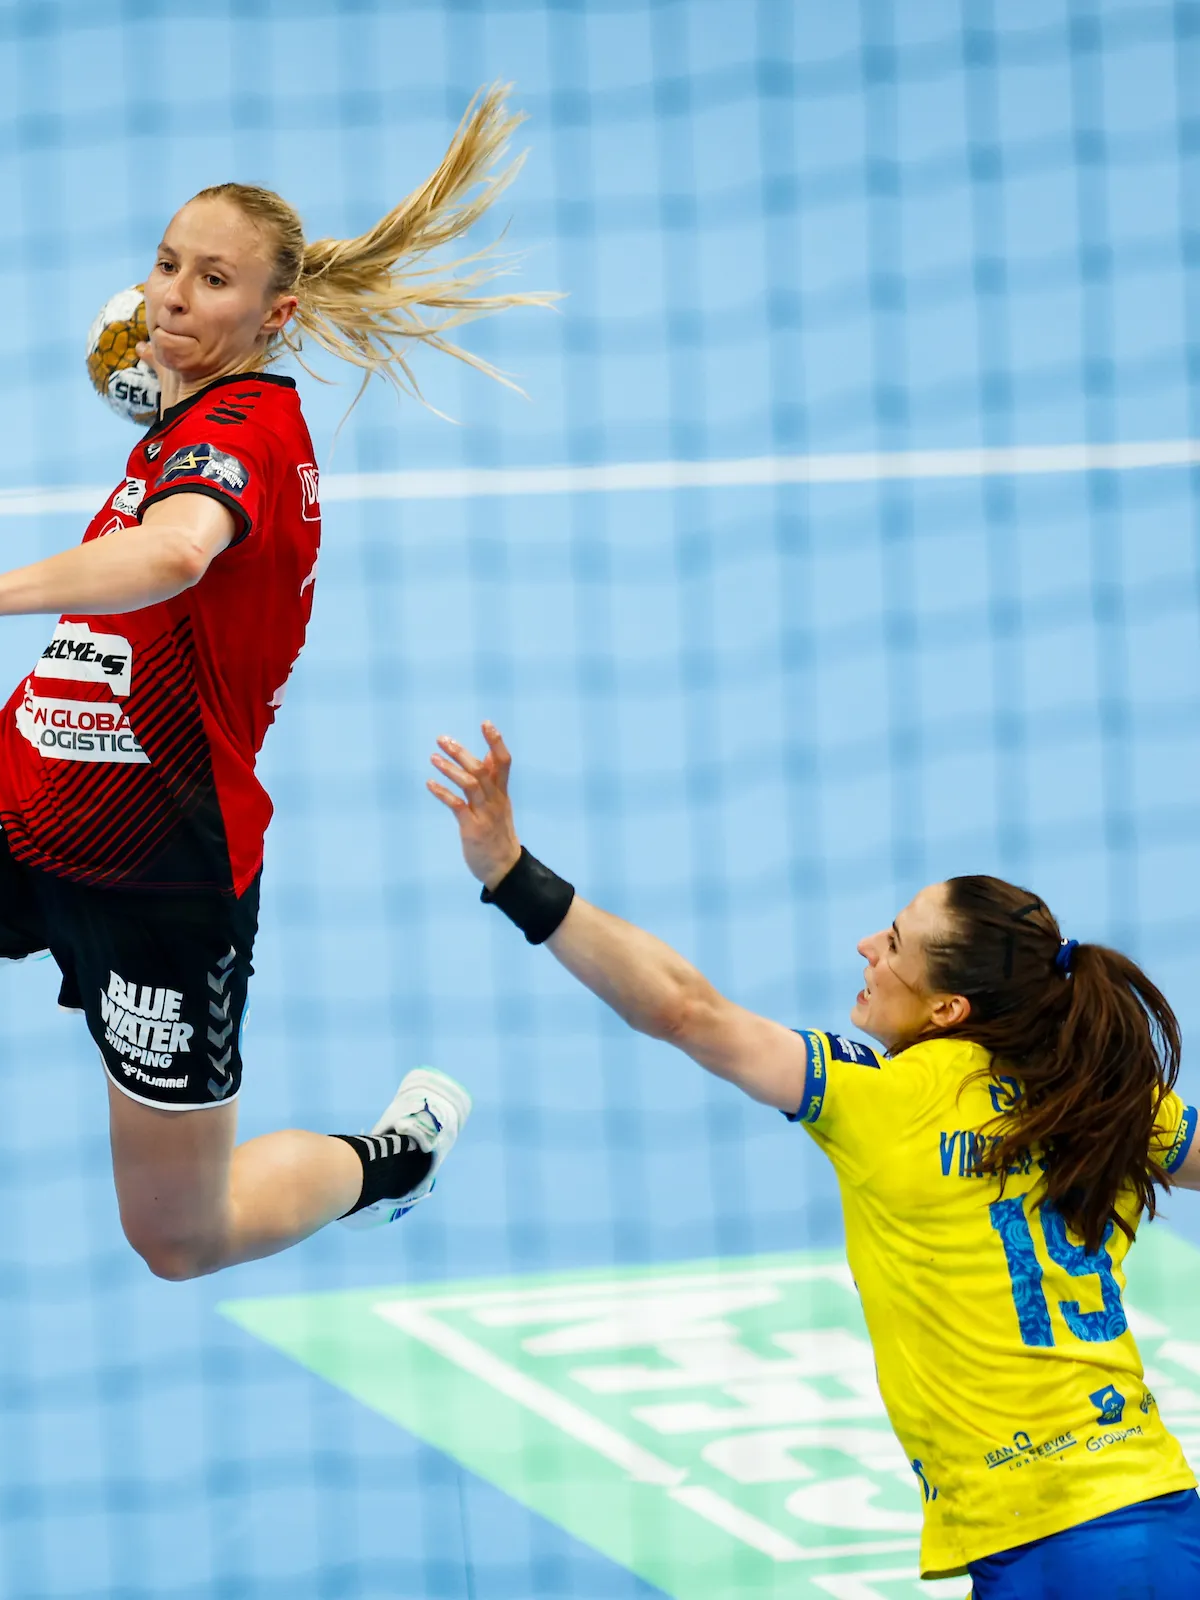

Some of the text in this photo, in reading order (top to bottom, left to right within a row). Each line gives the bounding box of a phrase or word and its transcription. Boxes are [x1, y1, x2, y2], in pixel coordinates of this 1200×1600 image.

[51, 709, 131, 731] GLOBA
[37, 729, 144, 752] OGISTICS
[107, 970, 183, 1021] BLUE
[100, 988, 194, 1052] WATER
[105, 1027, 173, 1068] SHIPPING
[808, 1034, 822, 1079] Kempa
[136, 1068, 189, 1089] hummel
[989, 1192, 1128, 1347] 19
[1086, 1425, 1143, 1451] Groupma
[984, 1446, 1013, 1465] JEAN
